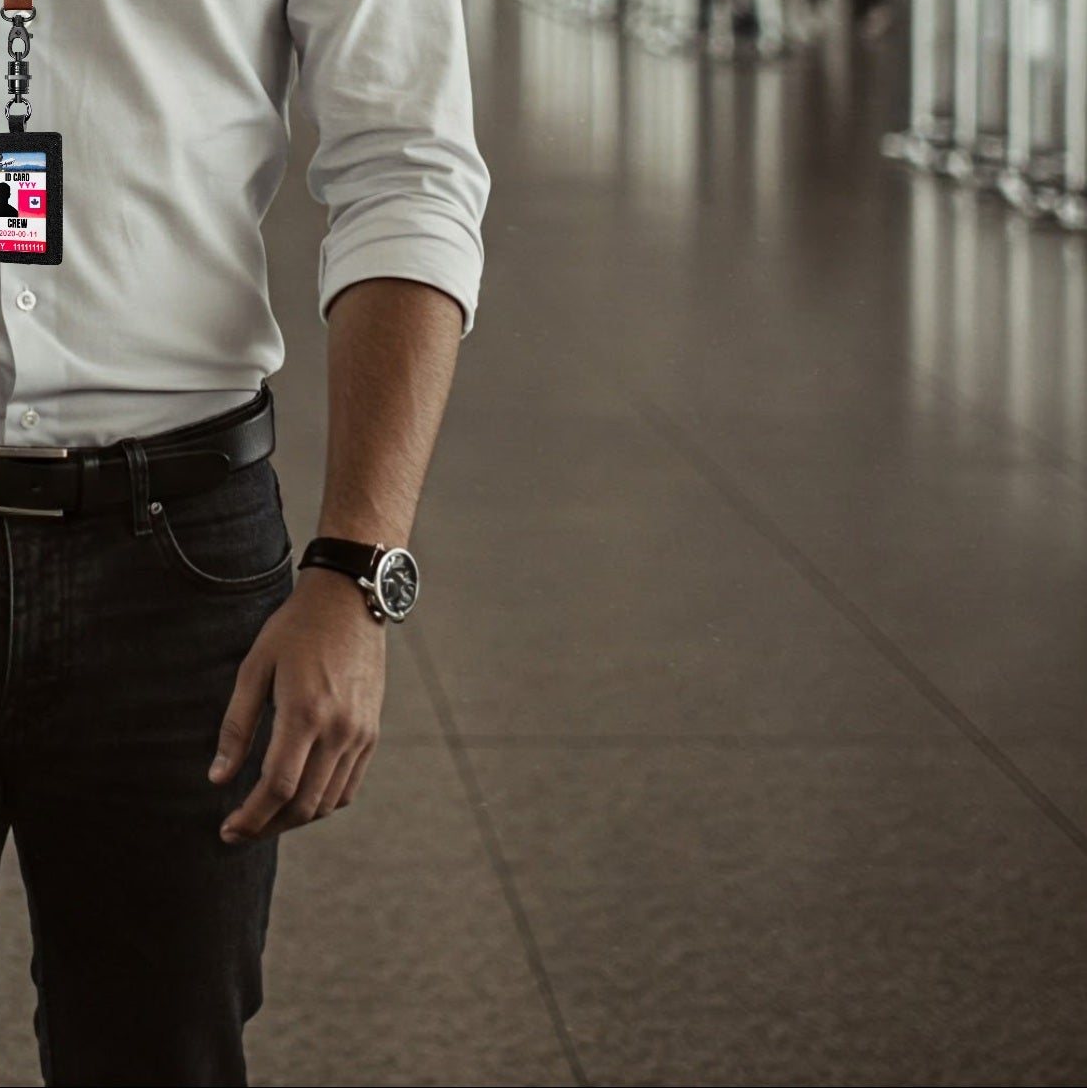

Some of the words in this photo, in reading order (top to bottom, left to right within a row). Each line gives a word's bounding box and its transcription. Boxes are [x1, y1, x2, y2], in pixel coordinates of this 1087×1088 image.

[5, 173, 11, 181] ID
[13, 173, 30, 181] CARD
[7, 218, 28, 228] CREW
